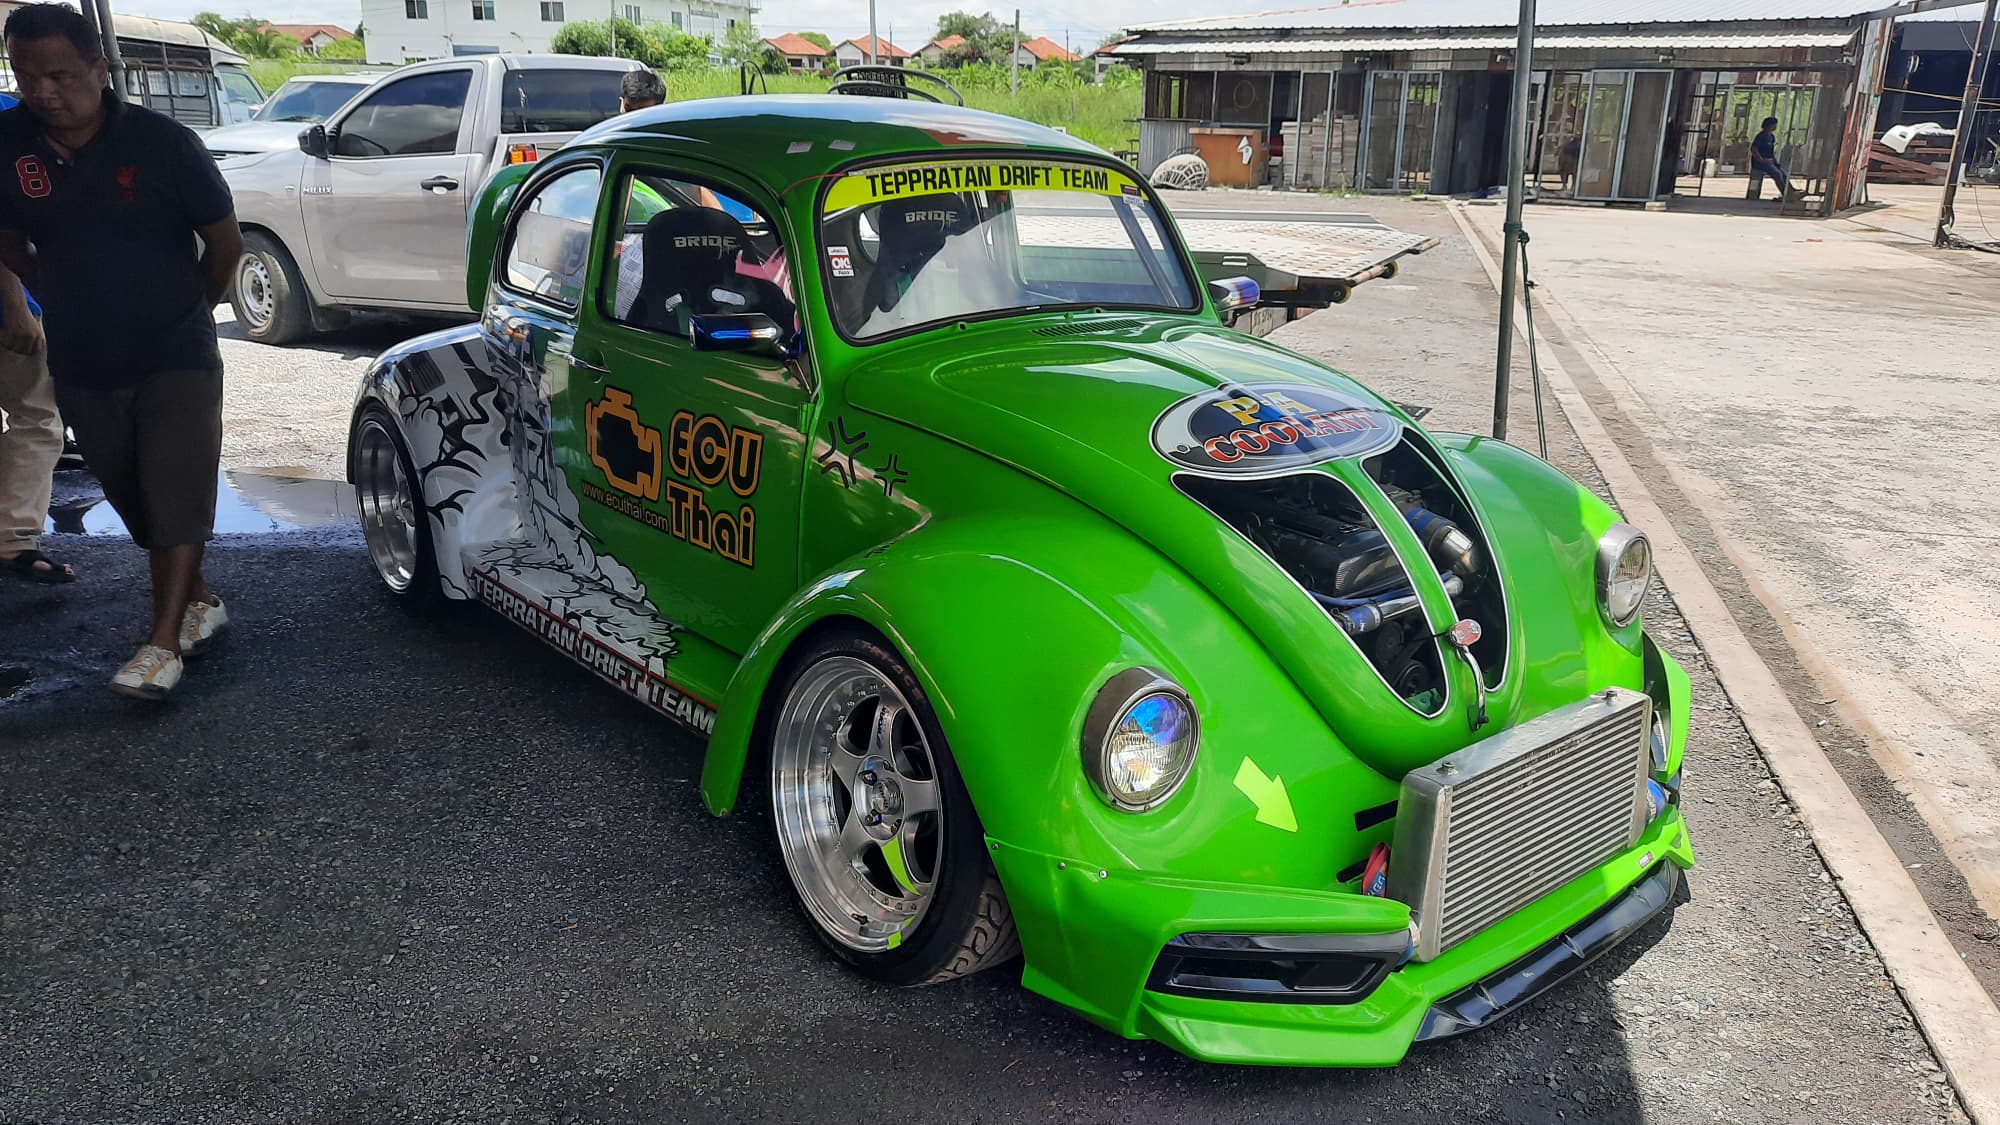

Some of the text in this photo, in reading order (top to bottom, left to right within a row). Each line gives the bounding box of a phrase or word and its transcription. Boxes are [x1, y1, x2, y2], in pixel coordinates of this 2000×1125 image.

[15, 153, 52, 199] 8
[866, 165, 1109, 197] TEPPRATAN DRIFT TEAM
[672, 235, 738, 253] BRIDE
[905, 210, 960, 227] BRIDE
[668, 410, 763, 498] ECU
[1203, 409, 1383, 463] COOLANT
[581, 479, 671, 535] www.ecuthai.com
[666, 479, 755, 567] Thai
[473, 572, 717, 735] TEPPRATAN DRIFT TEAM
